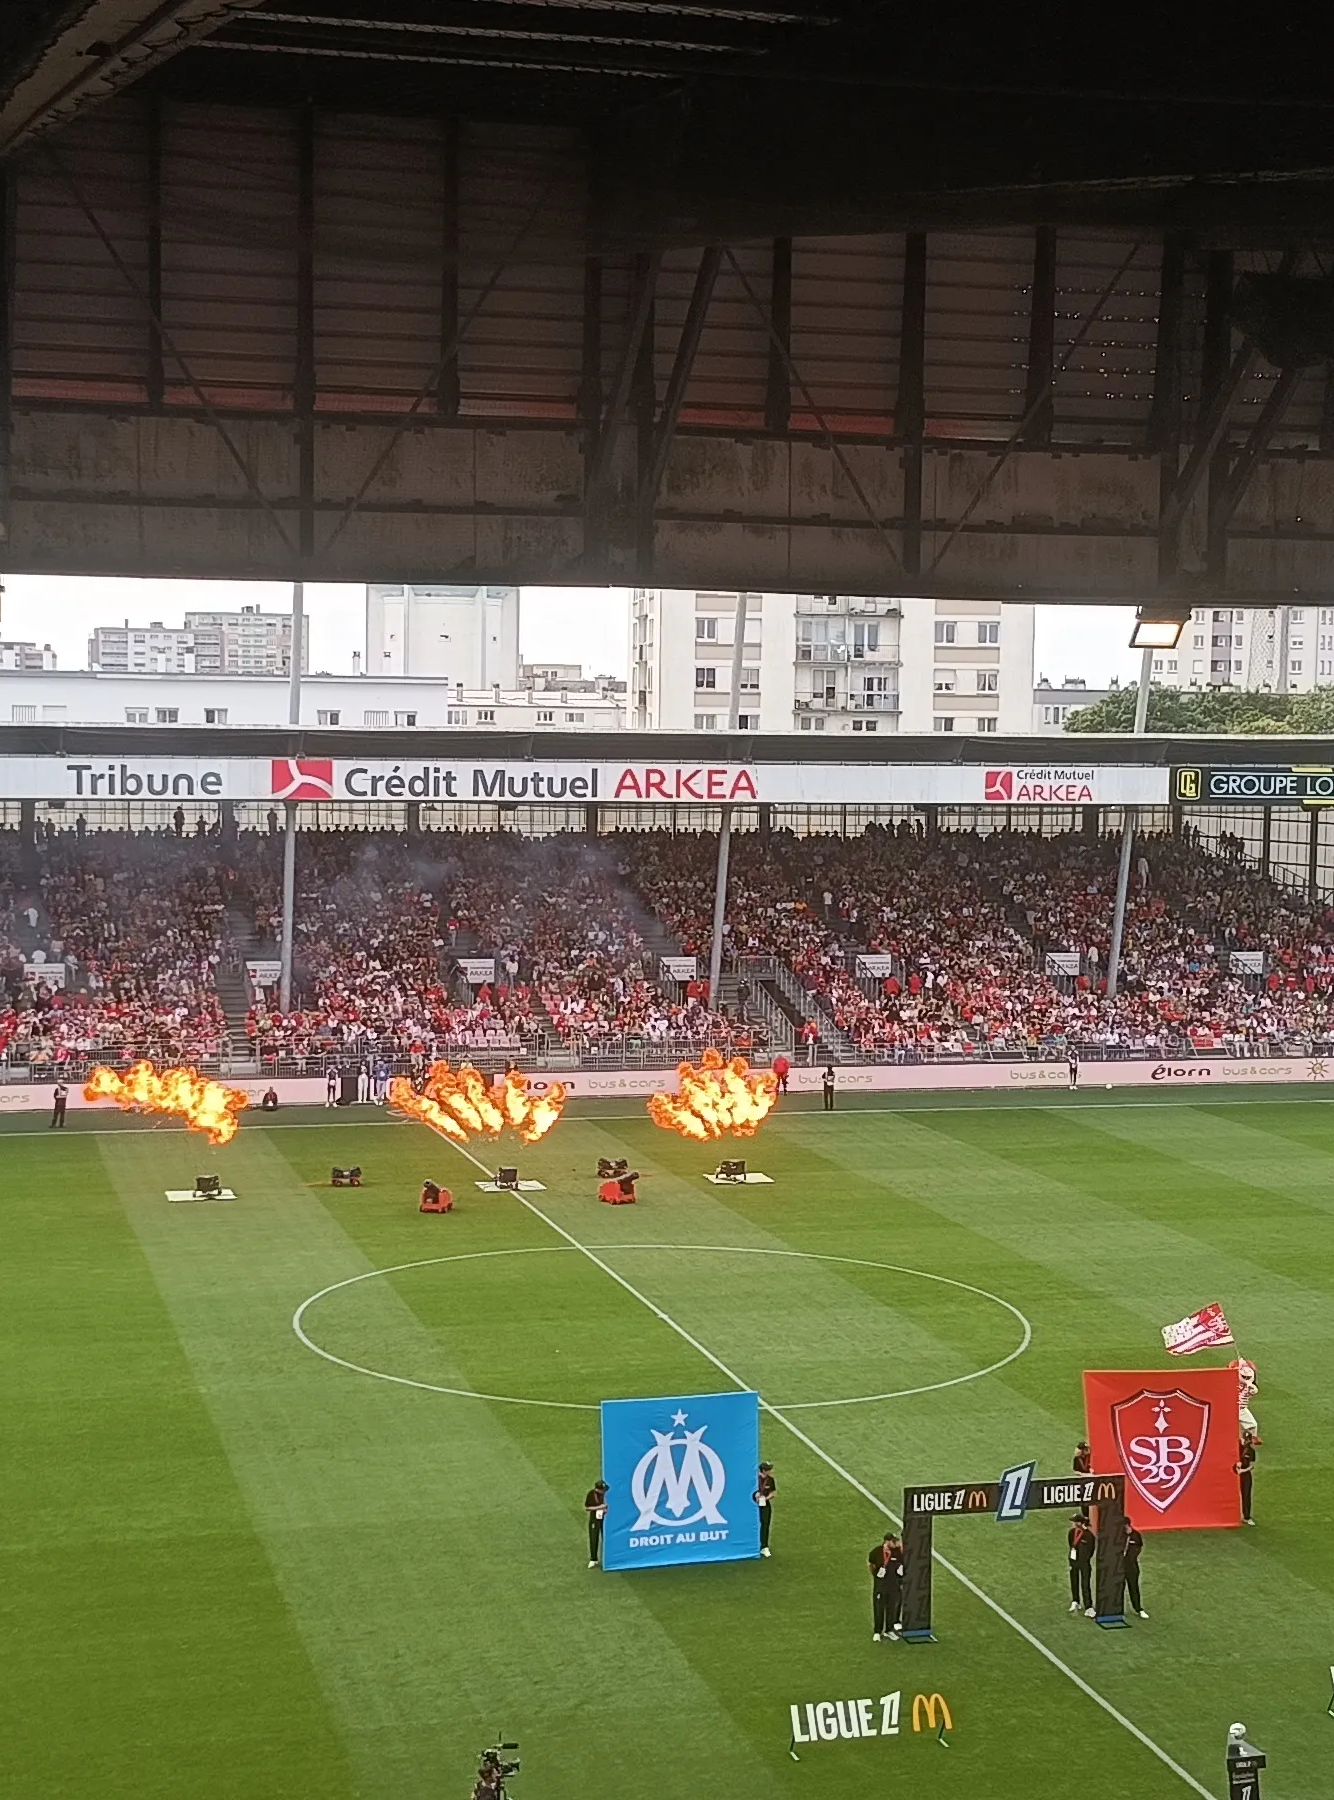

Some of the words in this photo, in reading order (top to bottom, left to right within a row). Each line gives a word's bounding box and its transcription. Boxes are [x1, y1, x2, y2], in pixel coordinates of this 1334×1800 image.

[66, 763, 223, 796] Tribune
[344, 766, 456, 797] Crédit
[473, 768, 597, 798] Mutuel
[614, 768, 757, 799] ARKEA
[1017, 770, 1051, 780] Crédit
[1054, 770, 1094, 780] Mutuel
[1017, 785, 1093, 801] ARKEA
[1210, 776, 1297, 795] GROUPE
[1151, 1064, 1210, 1080] élorn
[1129, 1436, 1194, 1468] SB
[1140, 1464, 1182, 1489] 29
[913, 1492, 952, 1512] LIGUE
[1043, 1484, 1082, 1504] LIGUE
[629, 1533, 674, 1548] DROIT
[676, 1532, 696, 1544] AU
[699, 1530, 729, 1542] BUT
[790, 1698, 877, 1743] LIGUE
